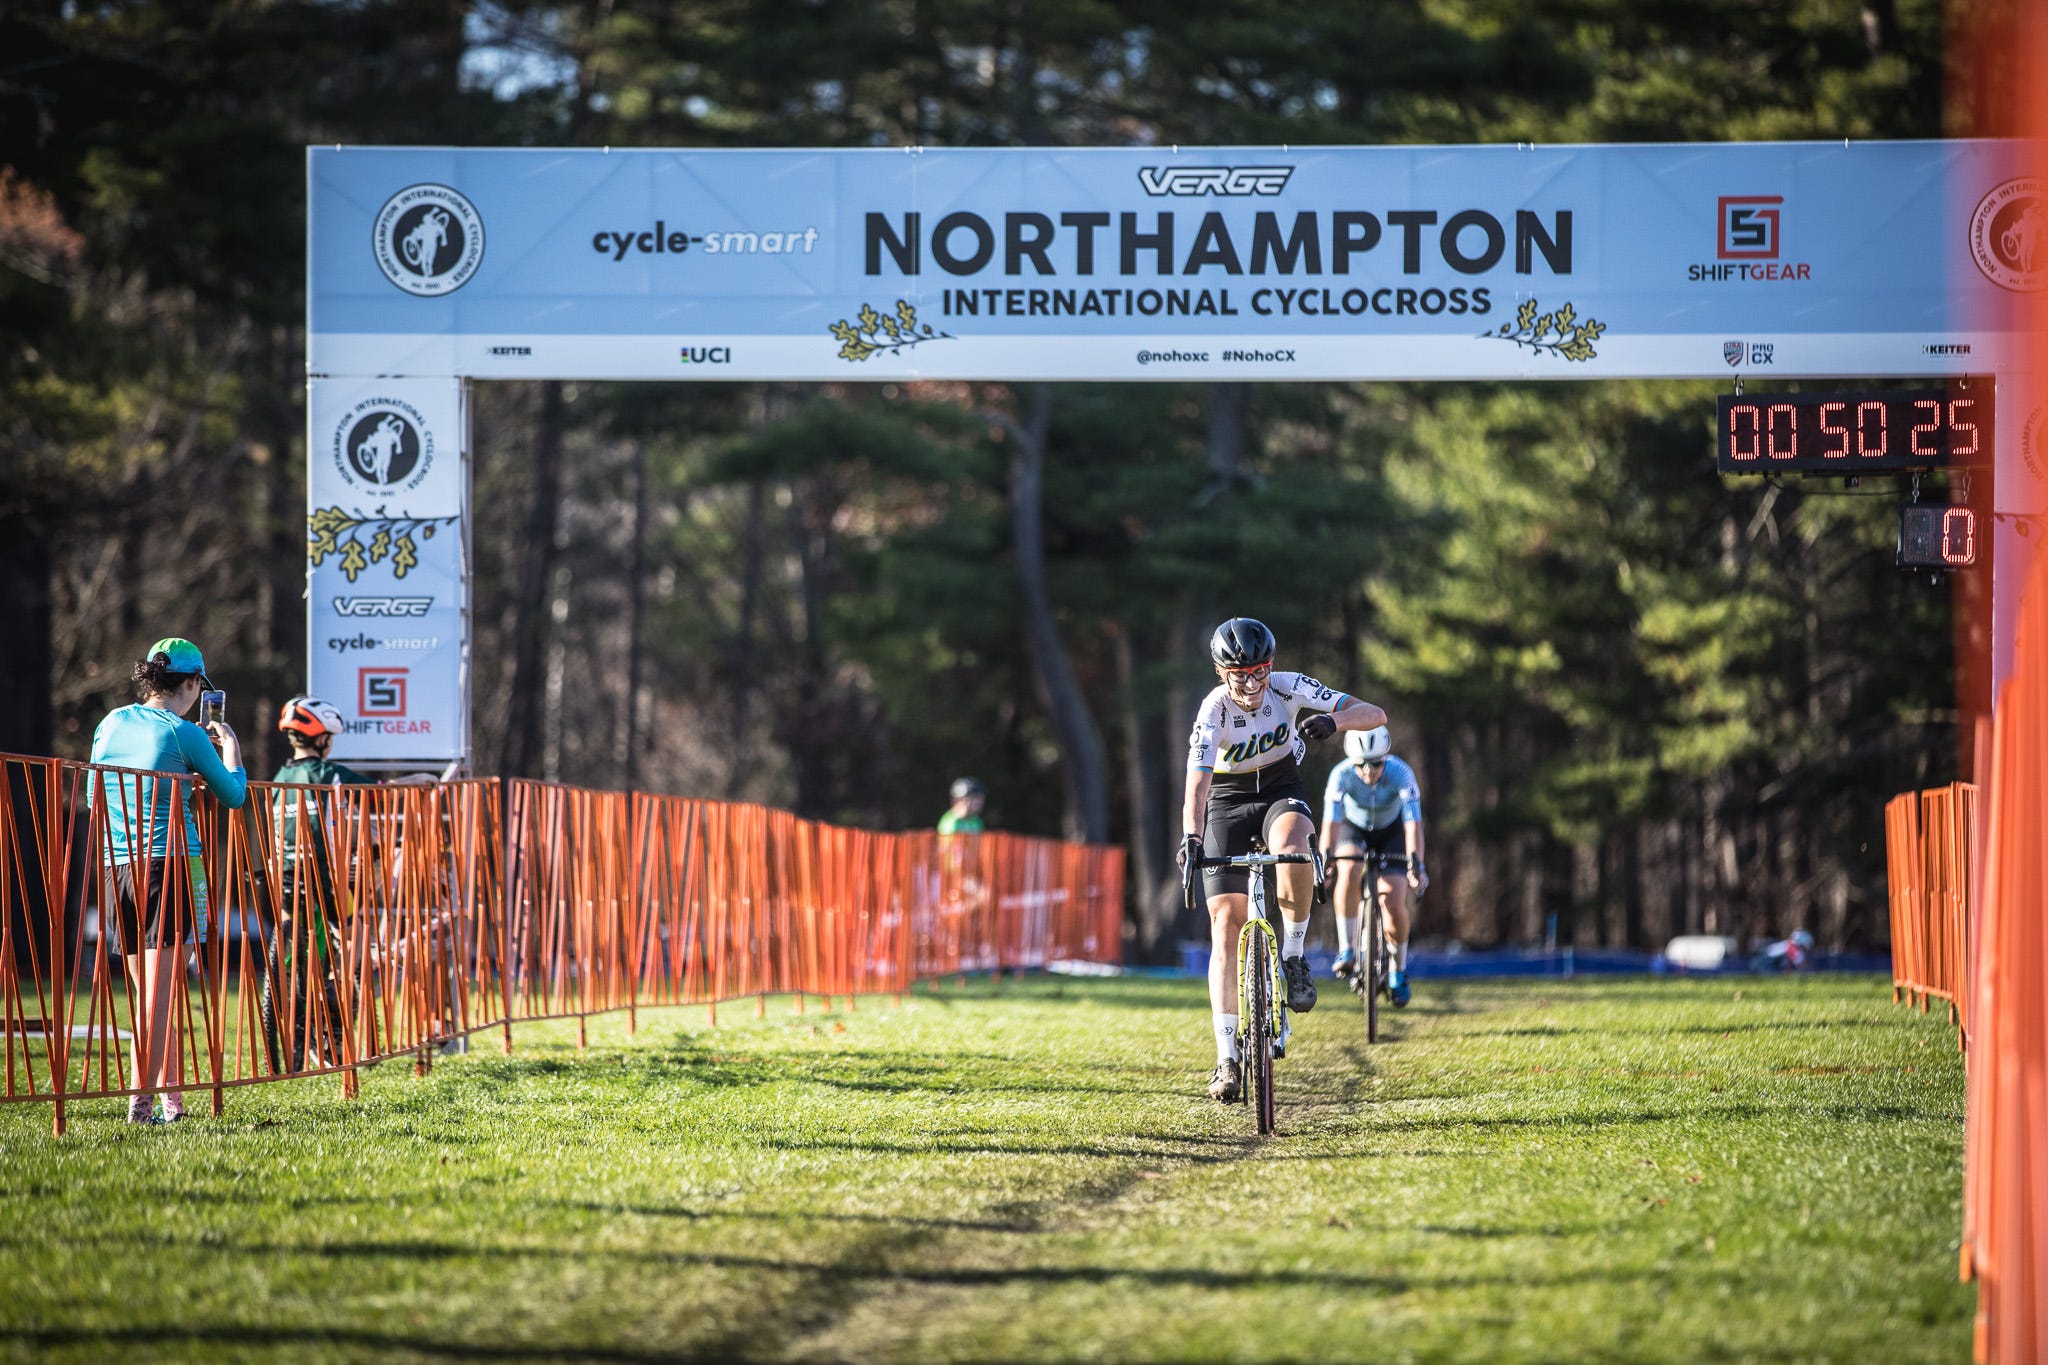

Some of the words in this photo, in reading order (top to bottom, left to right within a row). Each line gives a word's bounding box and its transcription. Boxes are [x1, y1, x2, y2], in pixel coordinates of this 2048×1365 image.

[1138, 165, 1296, 196] VERGE
[379, 204, 399, 277] NORTHAMPTON
[400, 189, 472, 219] INTERNATIONAL
[453, 223, 480, 283] CYCLOCROSS
[592, 219, 820, 262] cycle-smart
[864, 211, 1572, 275] NORTHAMPTON
[1975, 198, 1997, 273] NORTHAMPTON
[1688, 263, 1811, 282] SHIFTGEAR
[943, 289, 1238, 316] INTERNATIONAL
[1251, 289, 1492, 316] CYCLOCROSS
[492, 346, 532, 357] KEITER
[691, 347, 731, 363] UCI
[1137, 350, 1210, 364] @nohoxc
[1222, 349, 1296, 363] #NohoCX
[1752, 344, 1774, 353] PRO
[1752, 353, 1774, 365] CX
[1930, 344, 1971, 355] KEITER
[1730, 404, 1798, 461] 00
[1820, 401, 1887, 458] 50
[1911, 400, 1978, 456] 25
[1942, 508, 1974, 563] 0
[333, 597, 434, 617] VERGE
[328, 632, 438, 654] cycle-smart
[342, 720, 431, 735] HIFTGEAR
[1223, 722, 1291, 763] nice
